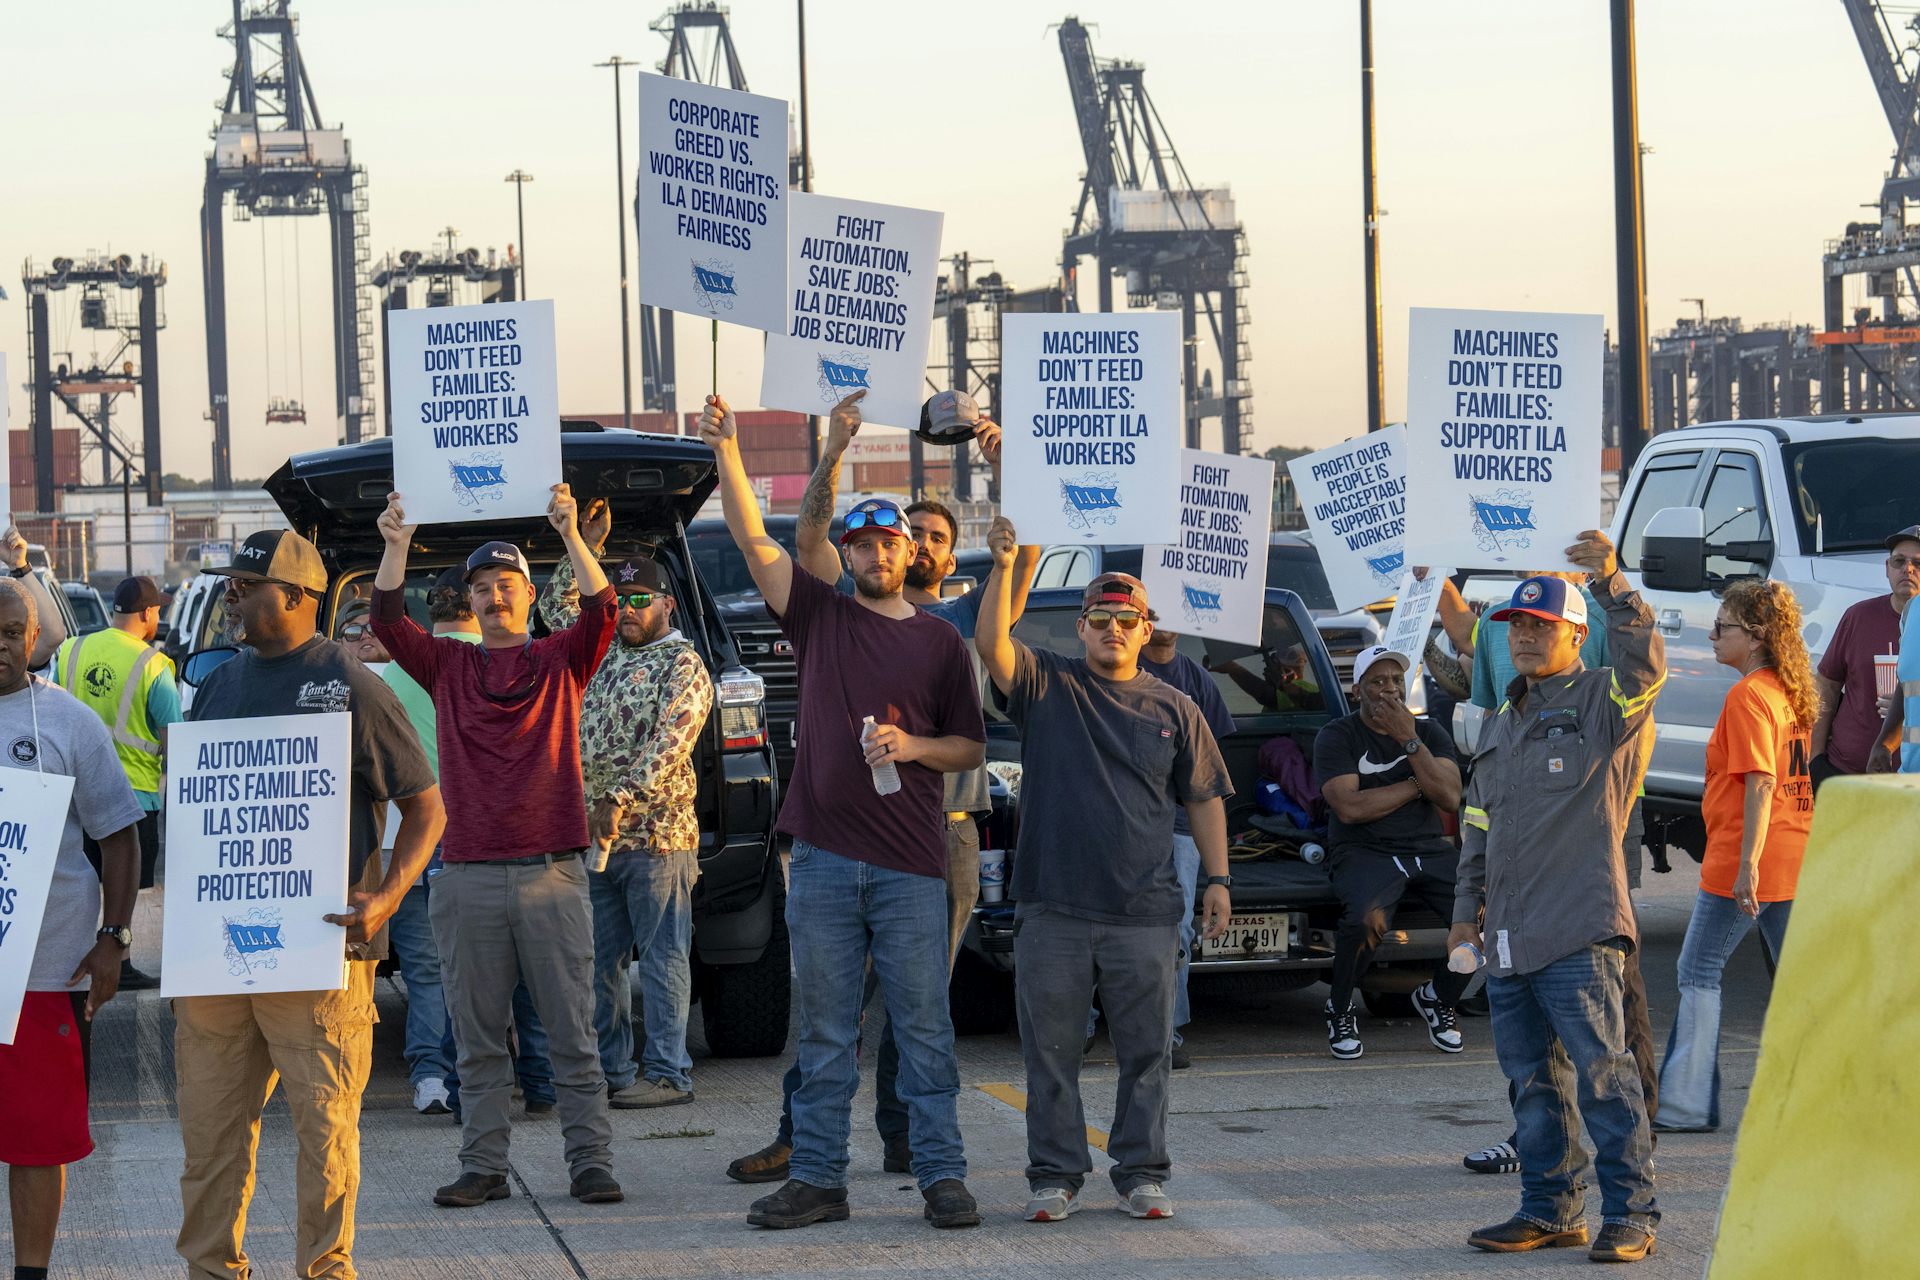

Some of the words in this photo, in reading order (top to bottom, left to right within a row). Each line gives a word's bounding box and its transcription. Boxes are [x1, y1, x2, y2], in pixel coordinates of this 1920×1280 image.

[669, 98, 759, 138] CORPORATE
[675, 128, 723, 159] GREED
[730, 141, 752, 166] VS.
[650, 151, 714, 186] WORKER
[721, 166, 779, 200] RIGHTS:
[662, 182, 685, 208] ILA
[692, 189, 767, 226] DEMANDS
[678, 214, 751, 251] FAIRNESS
[837, 215, 885, 243] FIGHT
[801, 237, 912, 276] AUTOMATION,
[808, 265, 852, 291] SAVE
[854, 271, 899, 298] JOBS:
[795, 289, 820, 314] ILA
[825, 294, 907, 326] DEMANDS
[428, 319, 516, 345] MACHINES
[791, 315, 821, 339] JOB
[825, 319, 906, 352] SECURITY
[1043, 331, 1139, 354] MACHINES
[1453, 329, 1559, 358] MACHINES
[425, 348, 475, 371] DON'T
[480, 344, 521, 367] FEED
[1039, 359, 1093, 382] DON'T
[1098, 359, 1143, 382] FEED
[433, 371, 516, 397] FAMILIES:
[1449, 360, 1508, 388] DON'T
[1513, 363, 1562, 389] FEED
[421, 397, 498, 424] SUPPORT
[503, 396, 529, 418] ILA
[1046, 386, 1135, 410] FAMILIES:
[1456, 392, 1553, 421] FAMILIES:
[434, 422, 518, 448] WORKERS
[1033, 414, 1115, 437] SUPPORT
[1120, 414, 1148, 437] ILA
[1441, 422, 1532, 451] SUPPORT
[1536, 426, 1567, 452] ILA
[1045, 442, 1136, 465] WORKERS
[1312, 456, 1357, 481] PROFIT
[1358, 442, 1392, 470] OVER
[1454, 454, 1553, 482] WORKERS
[1193, 465, 1230, 487] FIGHT
[1327, 469, 1375, 497] PEOPLE
[1379, 463, 1390, 481] IS
[1181, 485, 1251, 515] TOMATION,
[1181, 512, 1207, 529] AVE
[1208, 513, 1243, 535] JOBS:
[1332, 503, 1389, 536] SUPPORT
[1187, 534, 1249, 558] DEMANDS
[1346, 521, 1406, 551] WORKERS
[1161, 549, 1183, 569] JOB
[1187, 554, 1248, 580] SECURITY
[197, 736, 318, 770] AUTOMATION
[179, 775, 240, 804] HURTS
[244, 769, 336, 800] FAMILIES:
[203, 808, 232, 835] ILA
[236, 803, 310, 834] STANDS
[218, 839, 254, 868] FOR
[258, 838, 292, 866] JOB
[197, 870, 312, 902] PROTECTION
[1229, 917, 1265, 926] TEXAS
